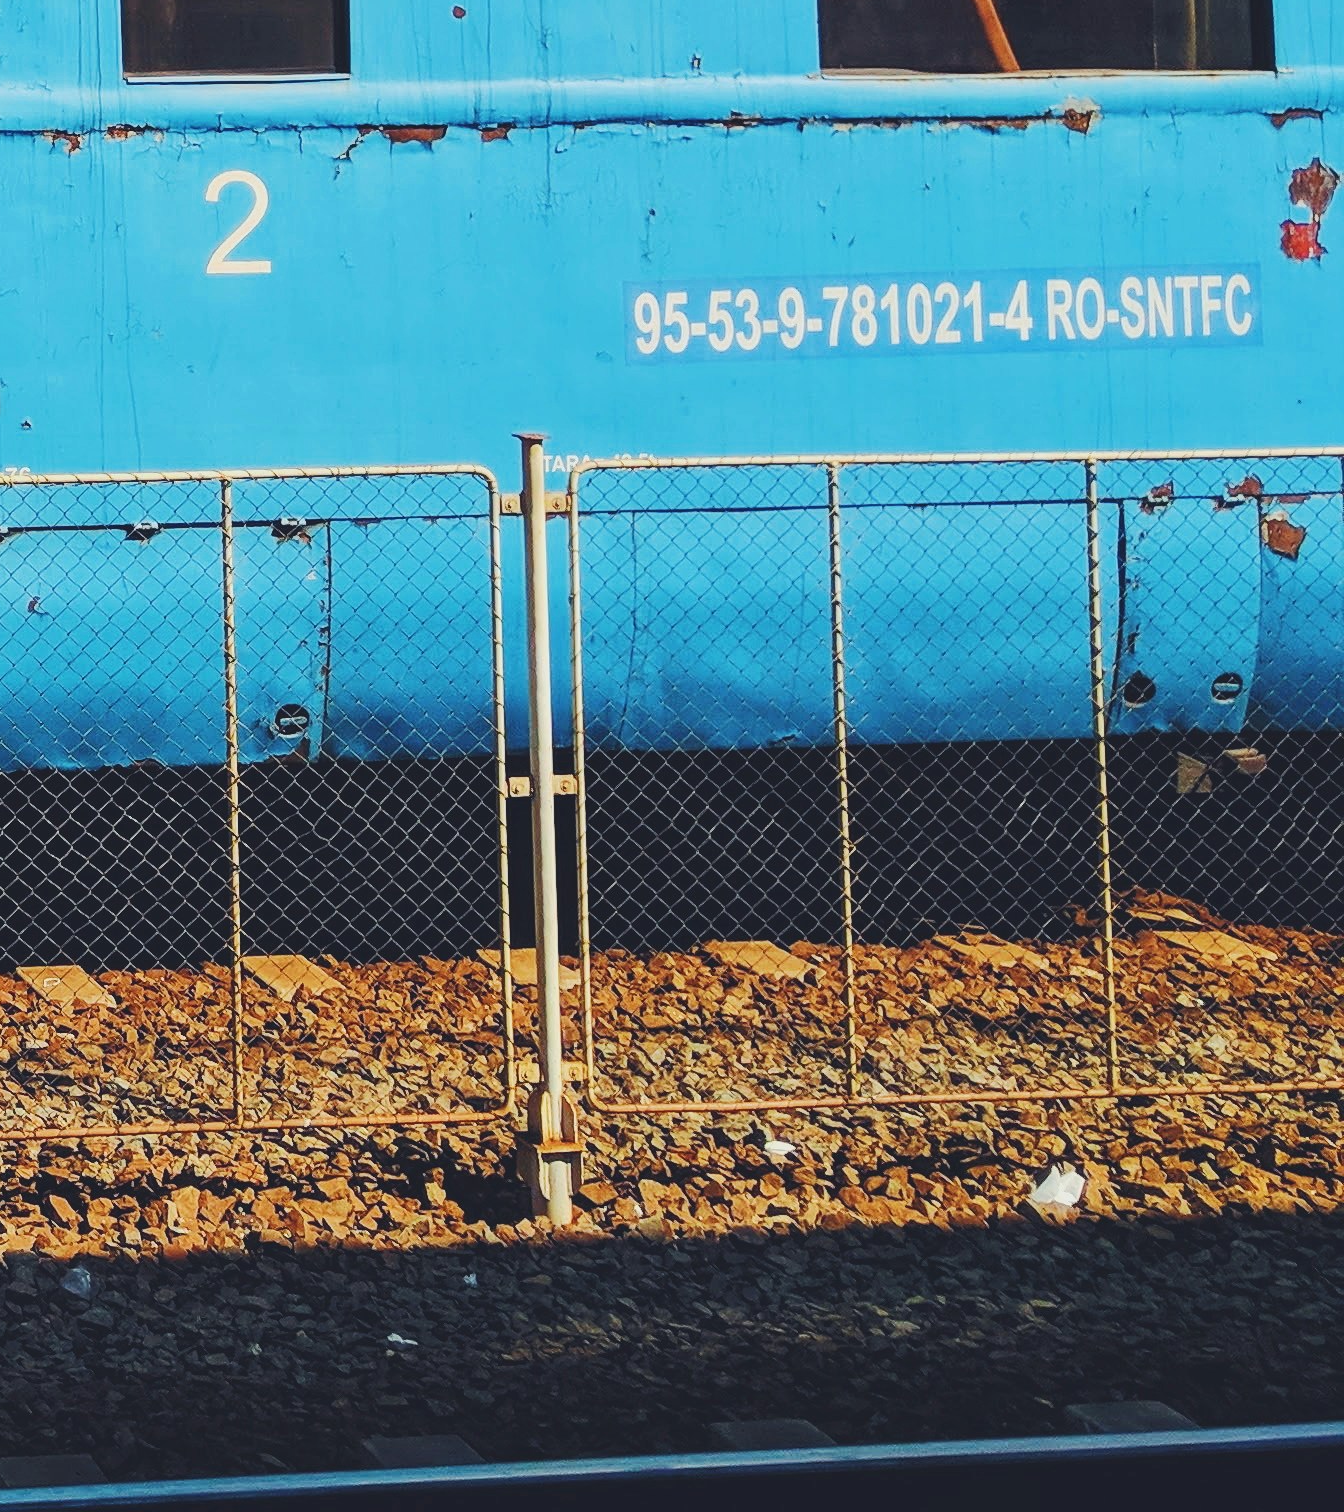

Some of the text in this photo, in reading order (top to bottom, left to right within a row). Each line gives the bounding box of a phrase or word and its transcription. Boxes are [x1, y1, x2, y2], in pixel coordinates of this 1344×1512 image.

[205, 170, 271, 274] 2
[634, 273, 1252, 355] 95-53-9-781021-4 RO-SNTFC
